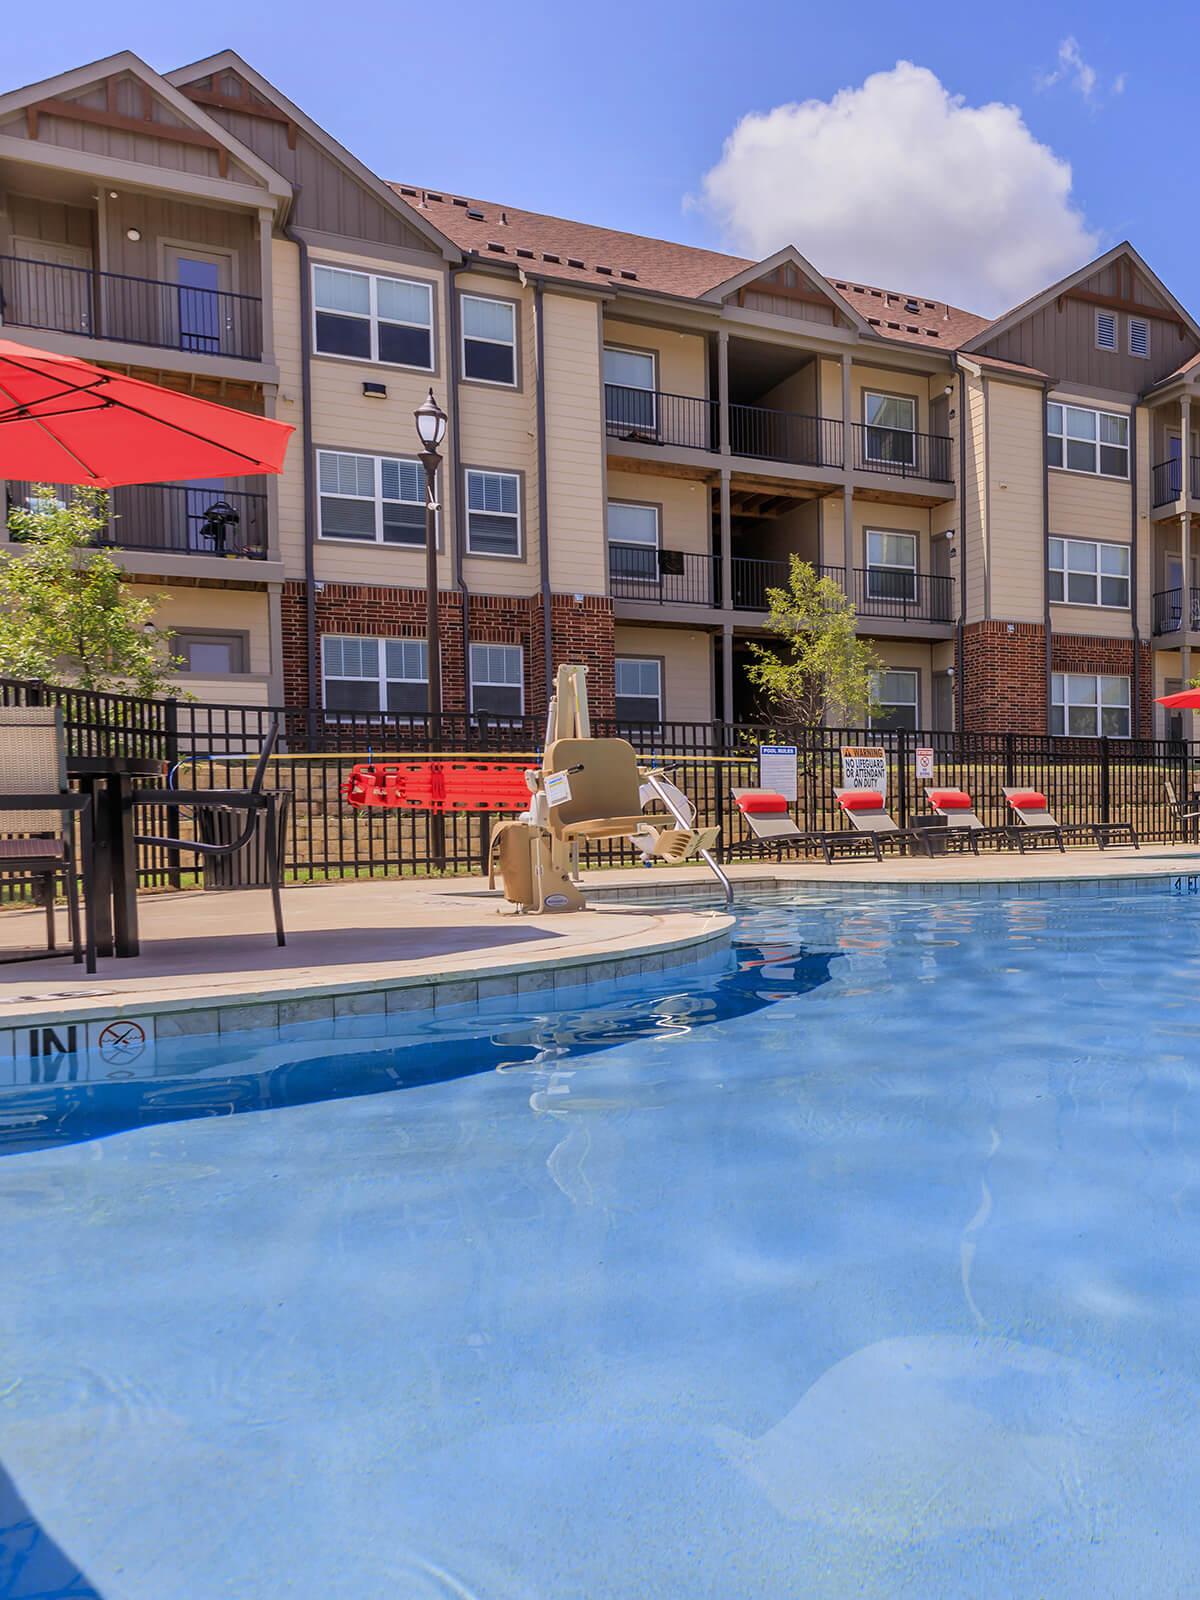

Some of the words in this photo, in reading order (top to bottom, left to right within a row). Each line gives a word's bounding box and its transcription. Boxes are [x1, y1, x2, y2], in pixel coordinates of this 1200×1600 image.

[853, 748, 883, 757] WARNING
[846, 759, 854, 768] NO
[856, 759, 884, 768] LIFEGUARD
[846, 769, 854, 777] OR
[855, 769, 885, 777] ATTENDANT
[854, 779, 863, 787] ON
[864, 779, 878, 787] DUTY
[30, 1026, 77, 1057] IN
